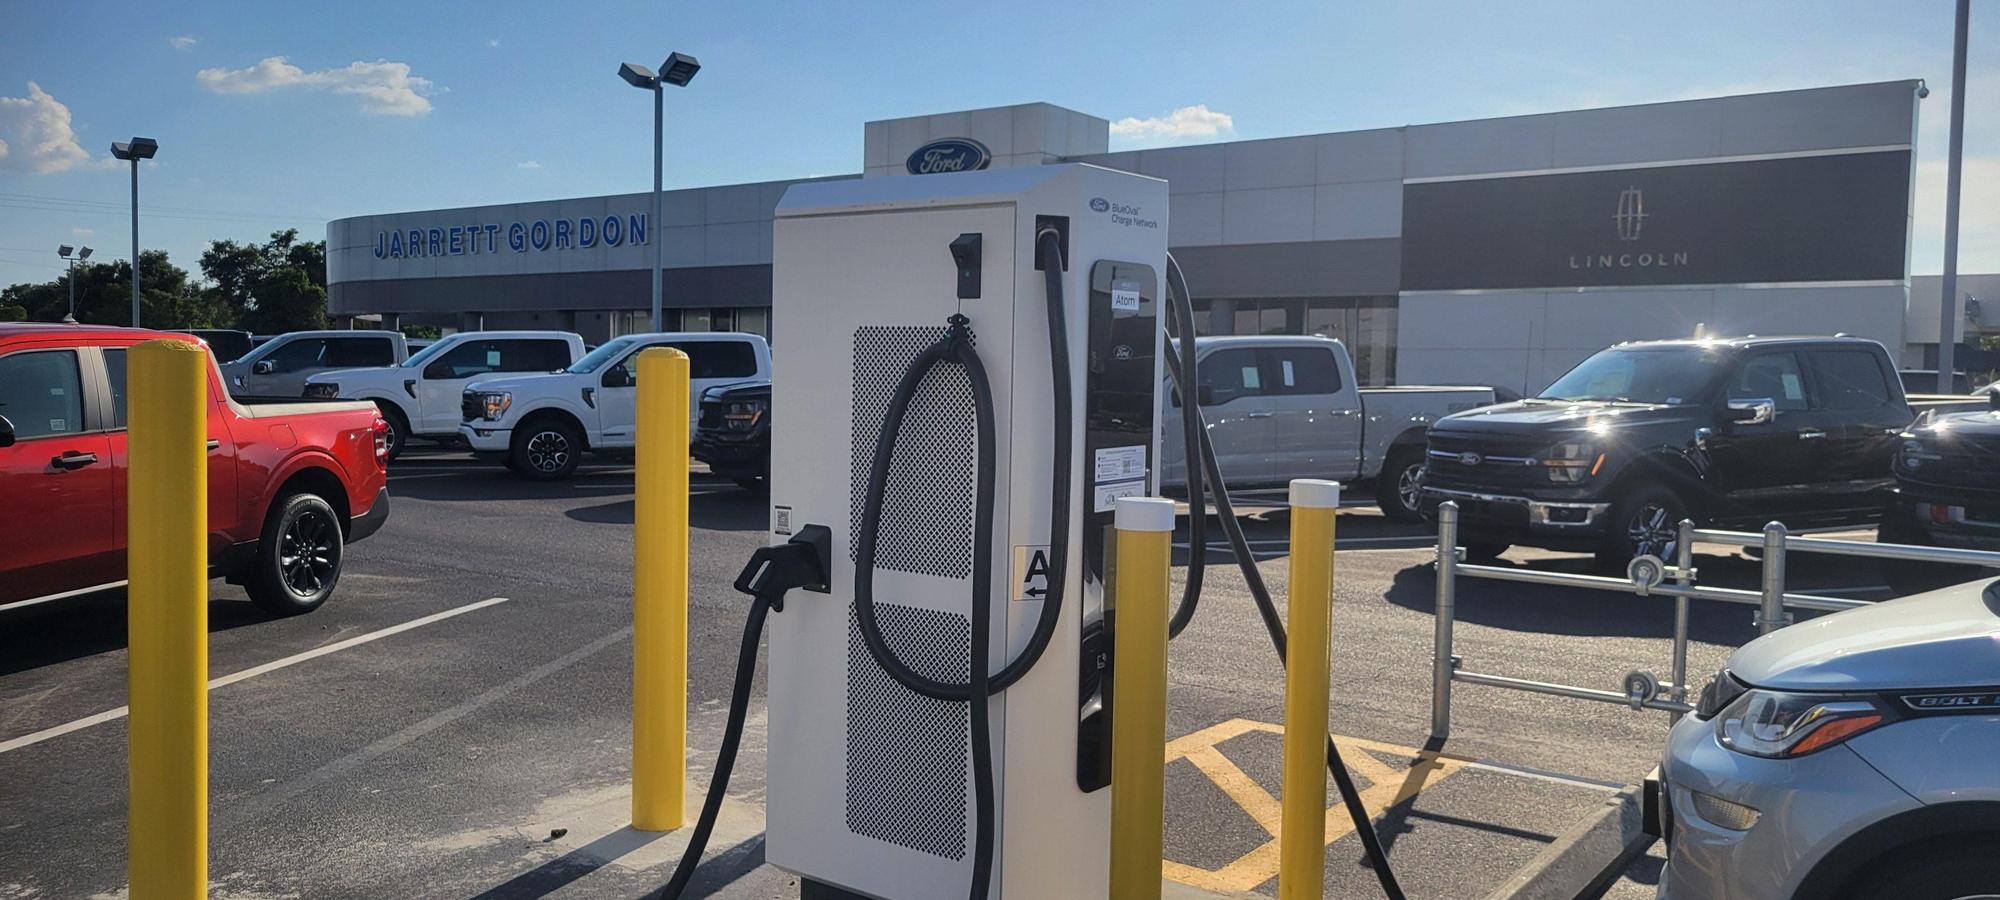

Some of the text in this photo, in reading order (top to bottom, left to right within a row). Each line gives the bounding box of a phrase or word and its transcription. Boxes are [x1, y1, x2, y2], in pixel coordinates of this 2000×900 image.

[920, 147, 967, 173] Ford
[1111, 213, 1158, 229] Charge Network
[374, 213, 647, 258] JARRETT GORDON
[1569, 251, 1688, 269] LINCOLN
[1115, 294, 1136, 306] Atom
[1024, 550, 1050, 583] A
[1919, 696, 1987, 706] BOLT
